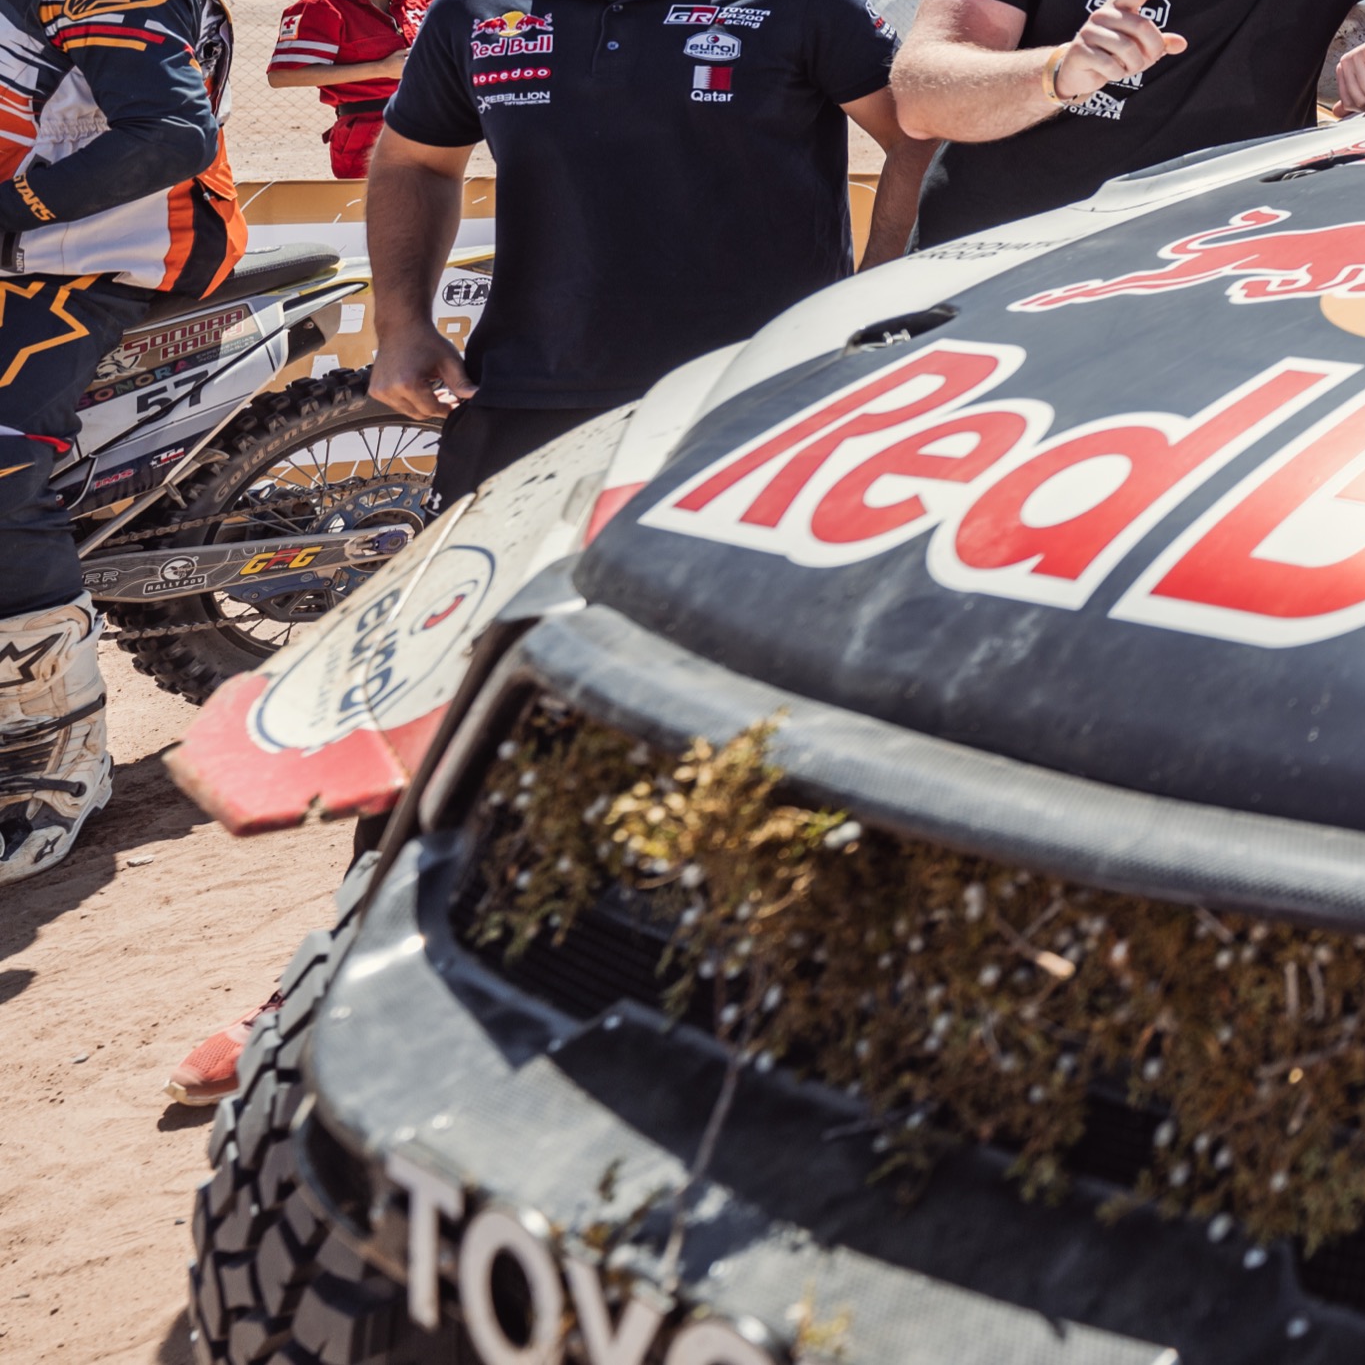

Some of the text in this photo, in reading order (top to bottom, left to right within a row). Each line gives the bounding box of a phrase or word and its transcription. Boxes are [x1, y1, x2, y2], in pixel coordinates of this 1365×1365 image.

[666, 11, 718, 24] GR
[719, 11, 764, 23] GAZOO
[720, 6, 771, 16] TOYOTA
[471, 34, 553, 59] Red Bull
[689, 42, 736, 54] eurol
[473, 67, 551, 87] ooredoo
[690, 90, 733, 103] Qatar
[122, 309, 245, 360] SONORA
[160, 323, 244, 362] RALLY
[77, 358, 193, 409] SONORA
[136, 369, 210, 423] 57
[637, 339, 1364, 610] Red
[336, 587, 408, 726] eurol
